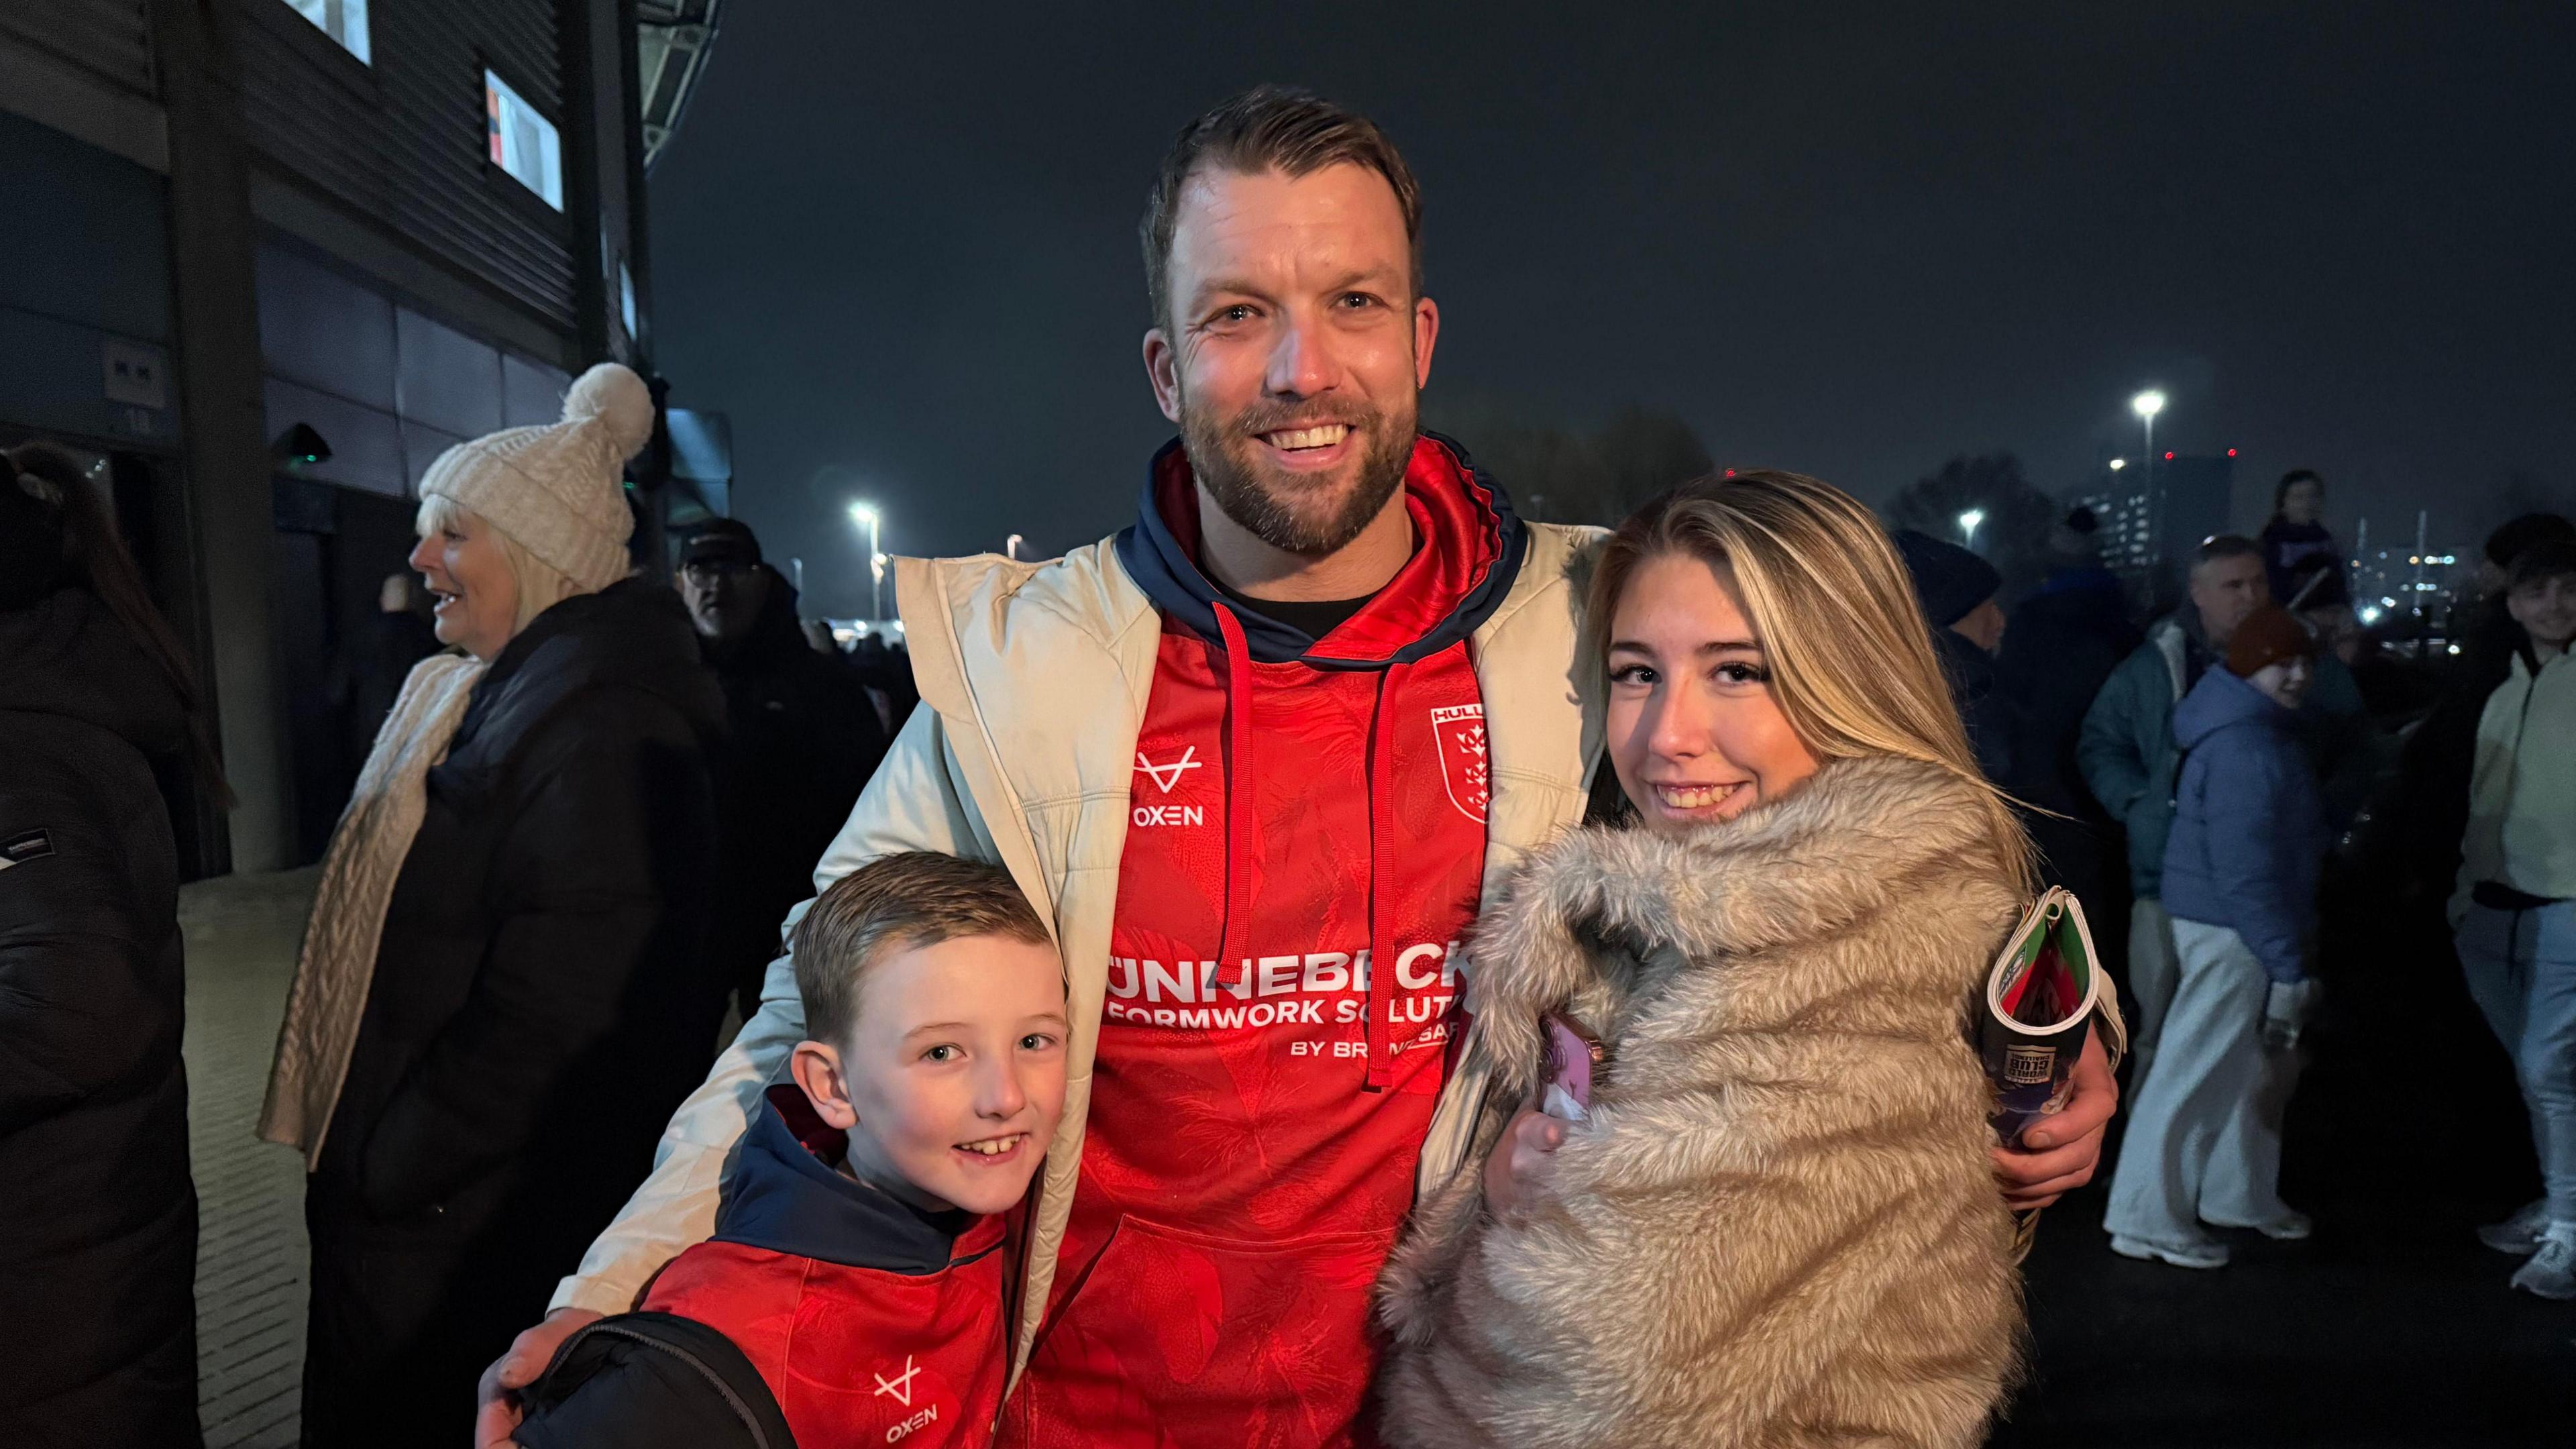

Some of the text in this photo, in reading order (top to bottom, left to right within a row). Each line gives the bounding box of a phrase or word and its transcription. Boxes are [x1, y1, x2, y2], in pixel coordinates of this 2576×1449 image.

[1434, 706, 1485, 720] HULL
[1133, 806, 1203, 826] OXEN
[1108, 999, 1326, 1029] FORMWORK
[1291, 1041, 1326, 1057] BY
[2008, 1068, 2047, 1077] WORLD
[2010, 1059, 2049, 1070] CLUB
[886, 1403, 937, 1444] OXEN
